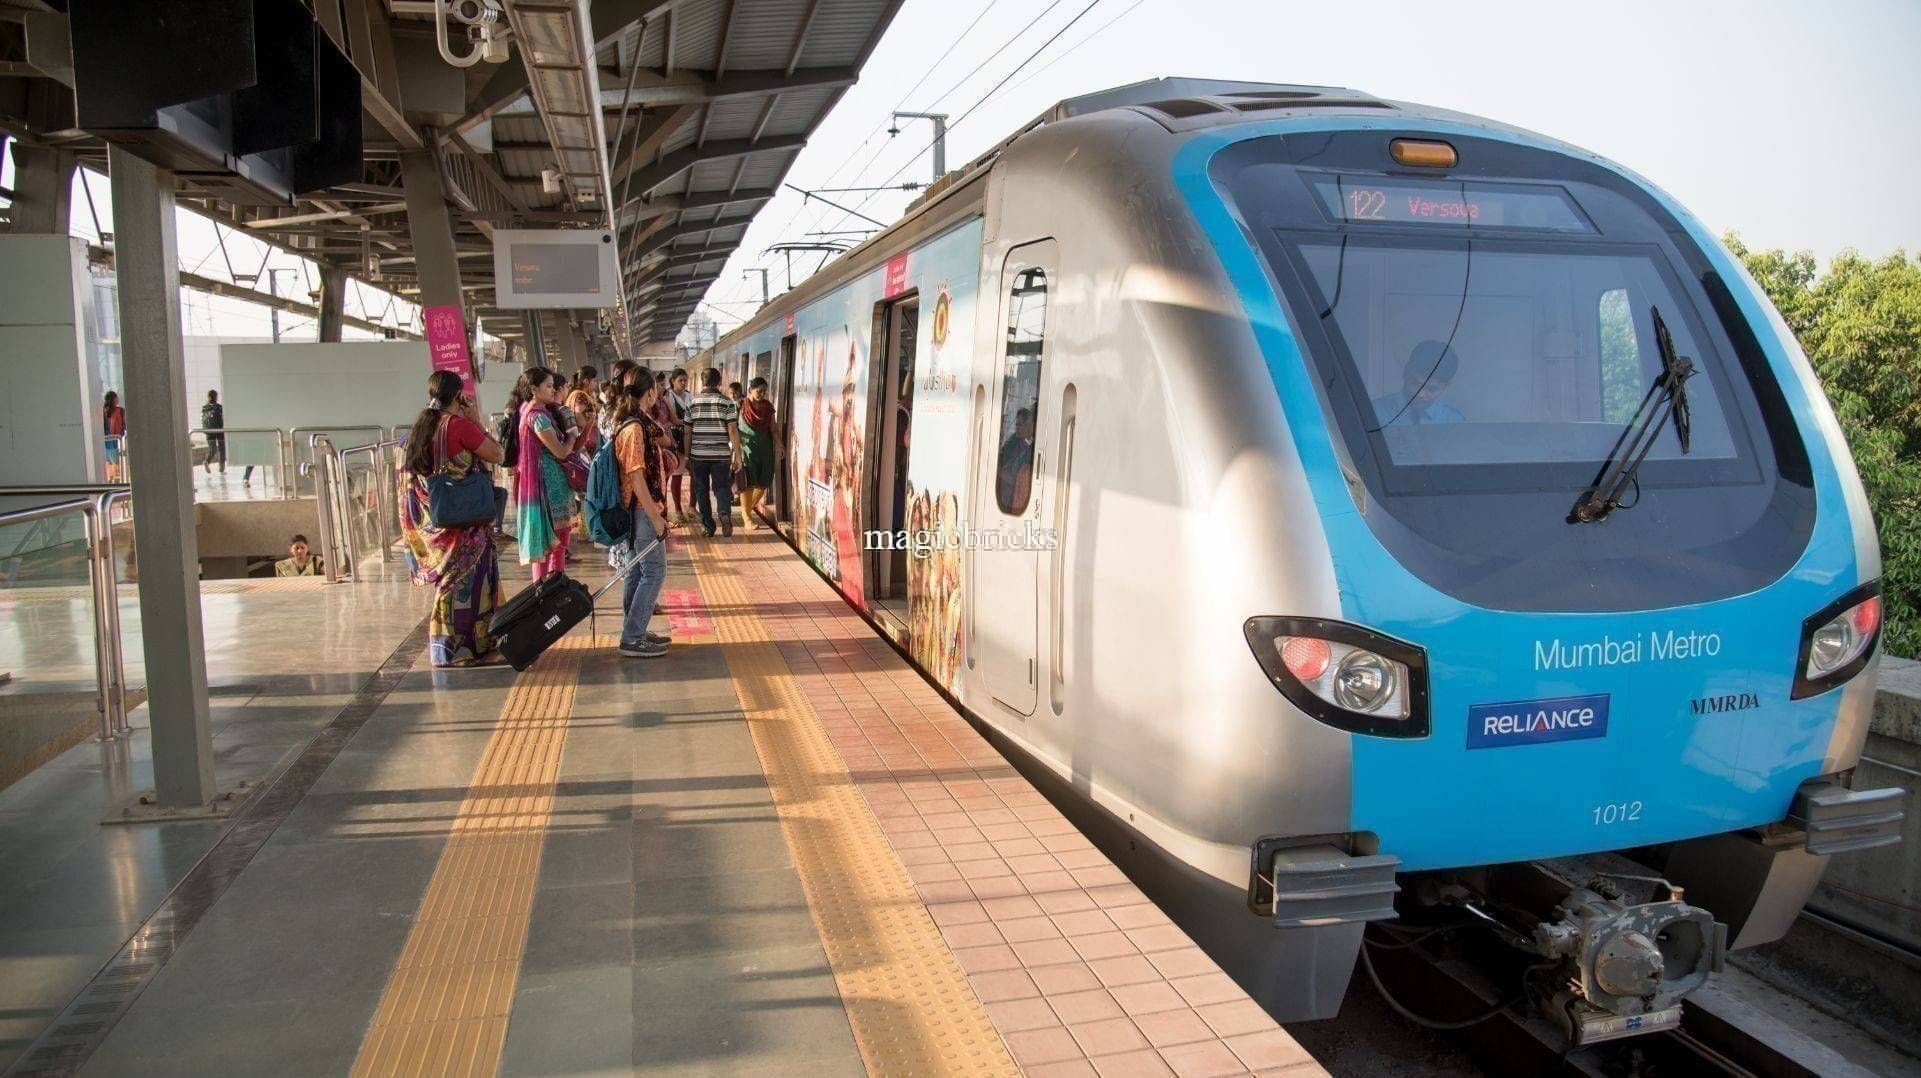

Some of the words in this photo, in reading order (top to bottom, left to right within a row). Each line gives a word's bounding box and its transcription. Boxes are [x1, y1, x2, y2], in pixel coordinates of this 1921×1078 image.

[1350, 190, 1386, 219] 122
[1408, 195, 1480, 219] Versova
[436, 343, 461, 352] Ladies
[441, 351, 458, 359] only
[1535, 633, 1641, 671] Mumbai
[1650, 630, 1721, 661] Metro
[1688, 693, 1760, 716] MMRDA
[1592, 801, 1642, 825] 1012
